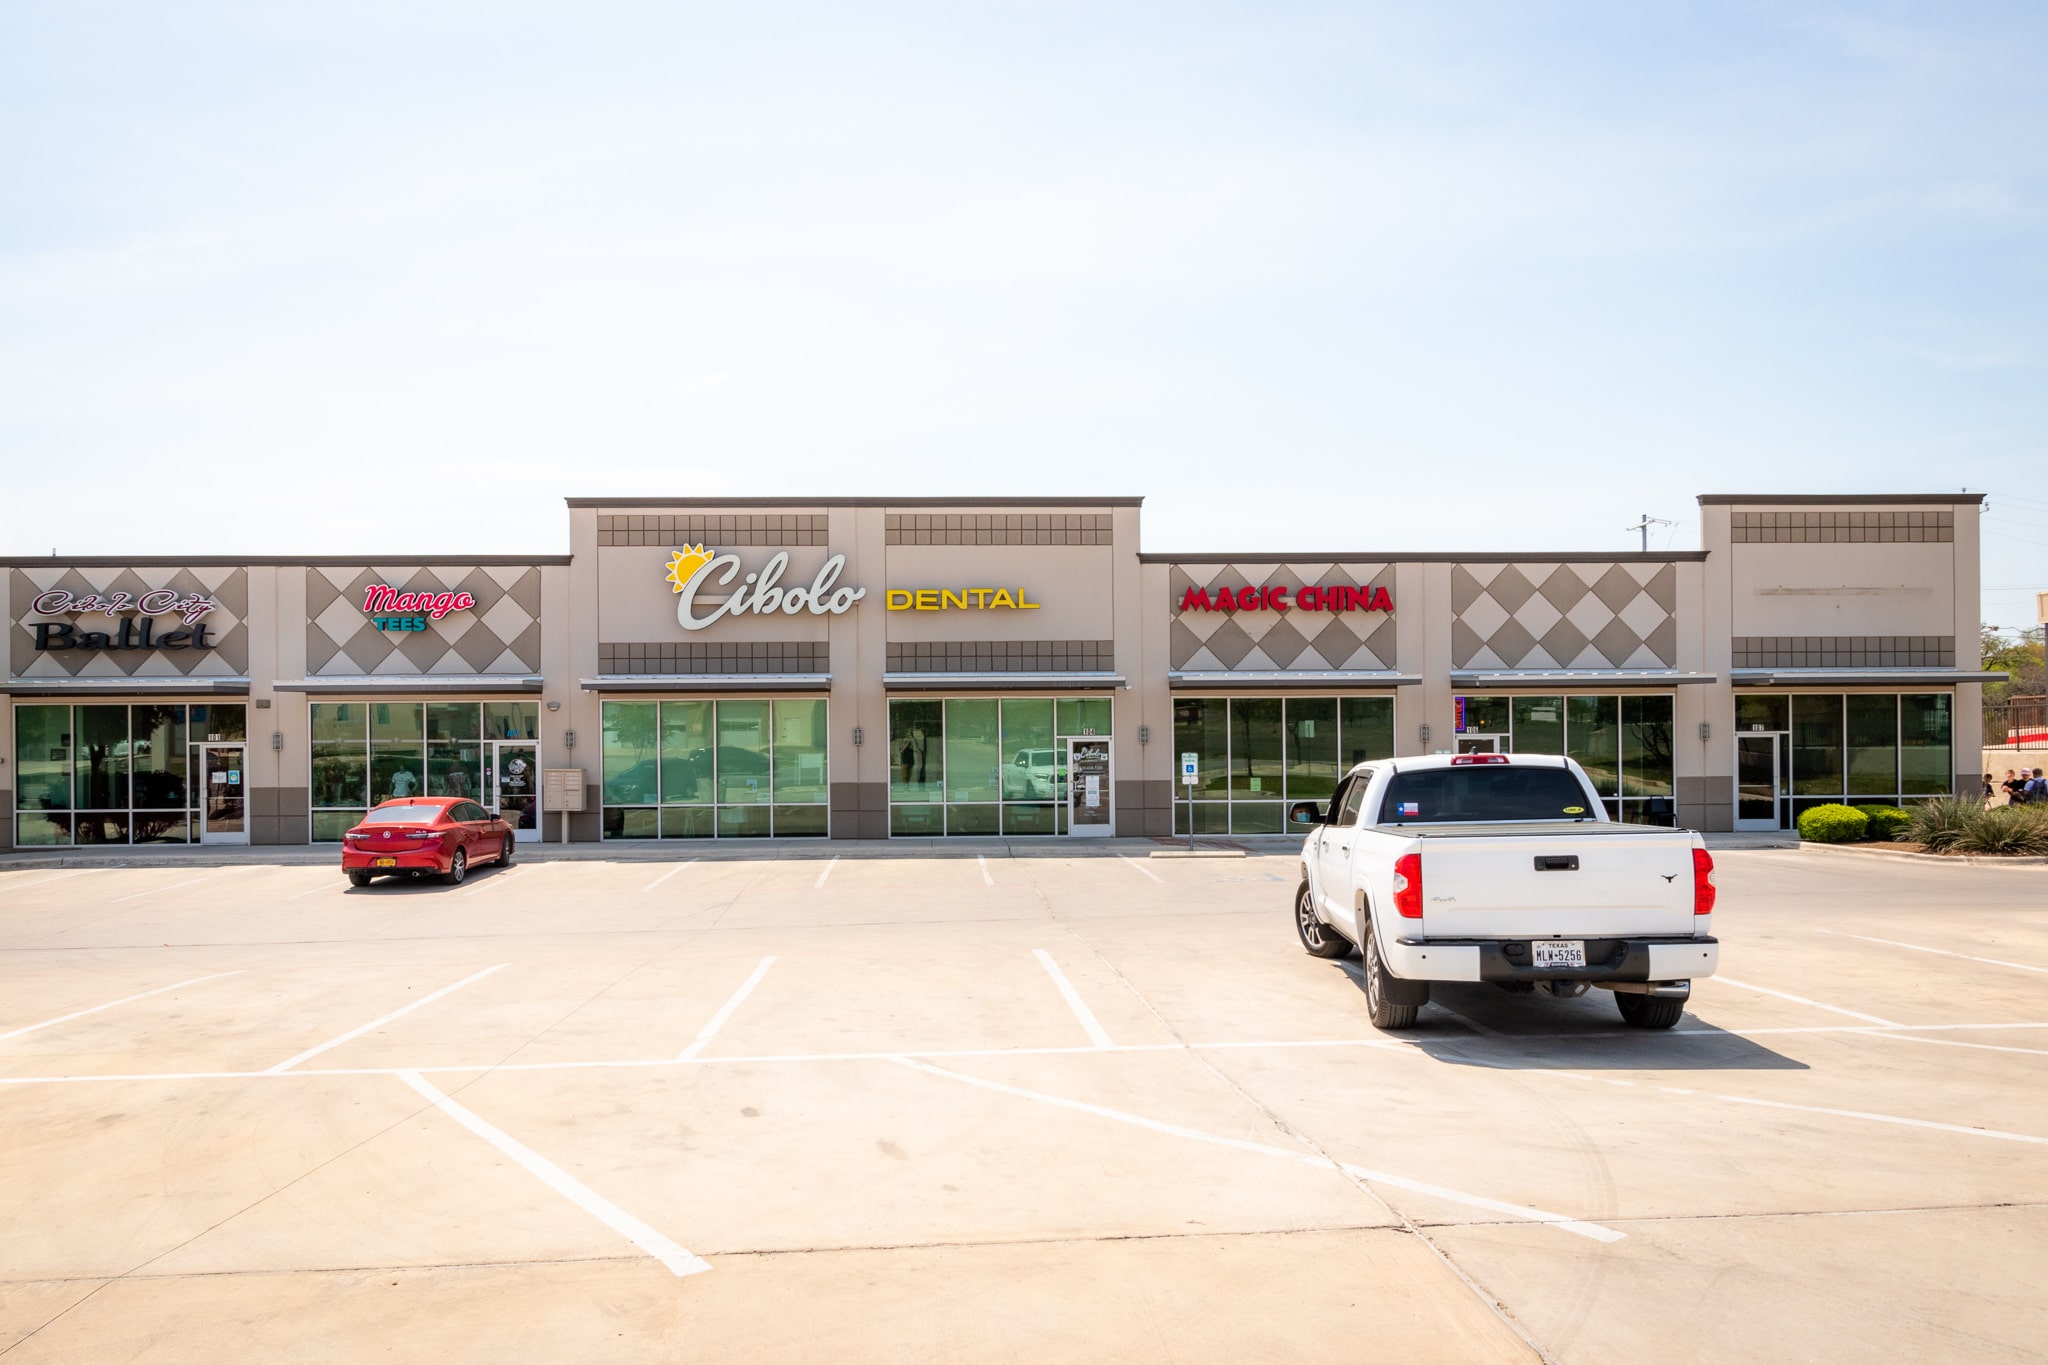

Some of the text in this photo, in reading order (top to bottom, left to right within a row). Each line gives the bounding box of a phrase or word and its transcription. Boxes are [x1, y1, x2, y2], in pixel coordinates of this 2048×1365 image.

[32, 589, 216, 625] Cibolo City
[364, 584, 475, 620] Mango
[676, 551, 1041, 631] Cibolo DENTAL
[1181, 585, 1394, 612] MAGIC CHINA
[28, 617, 217, 651] Ballet
[373, 616, 427, 632] TEES
